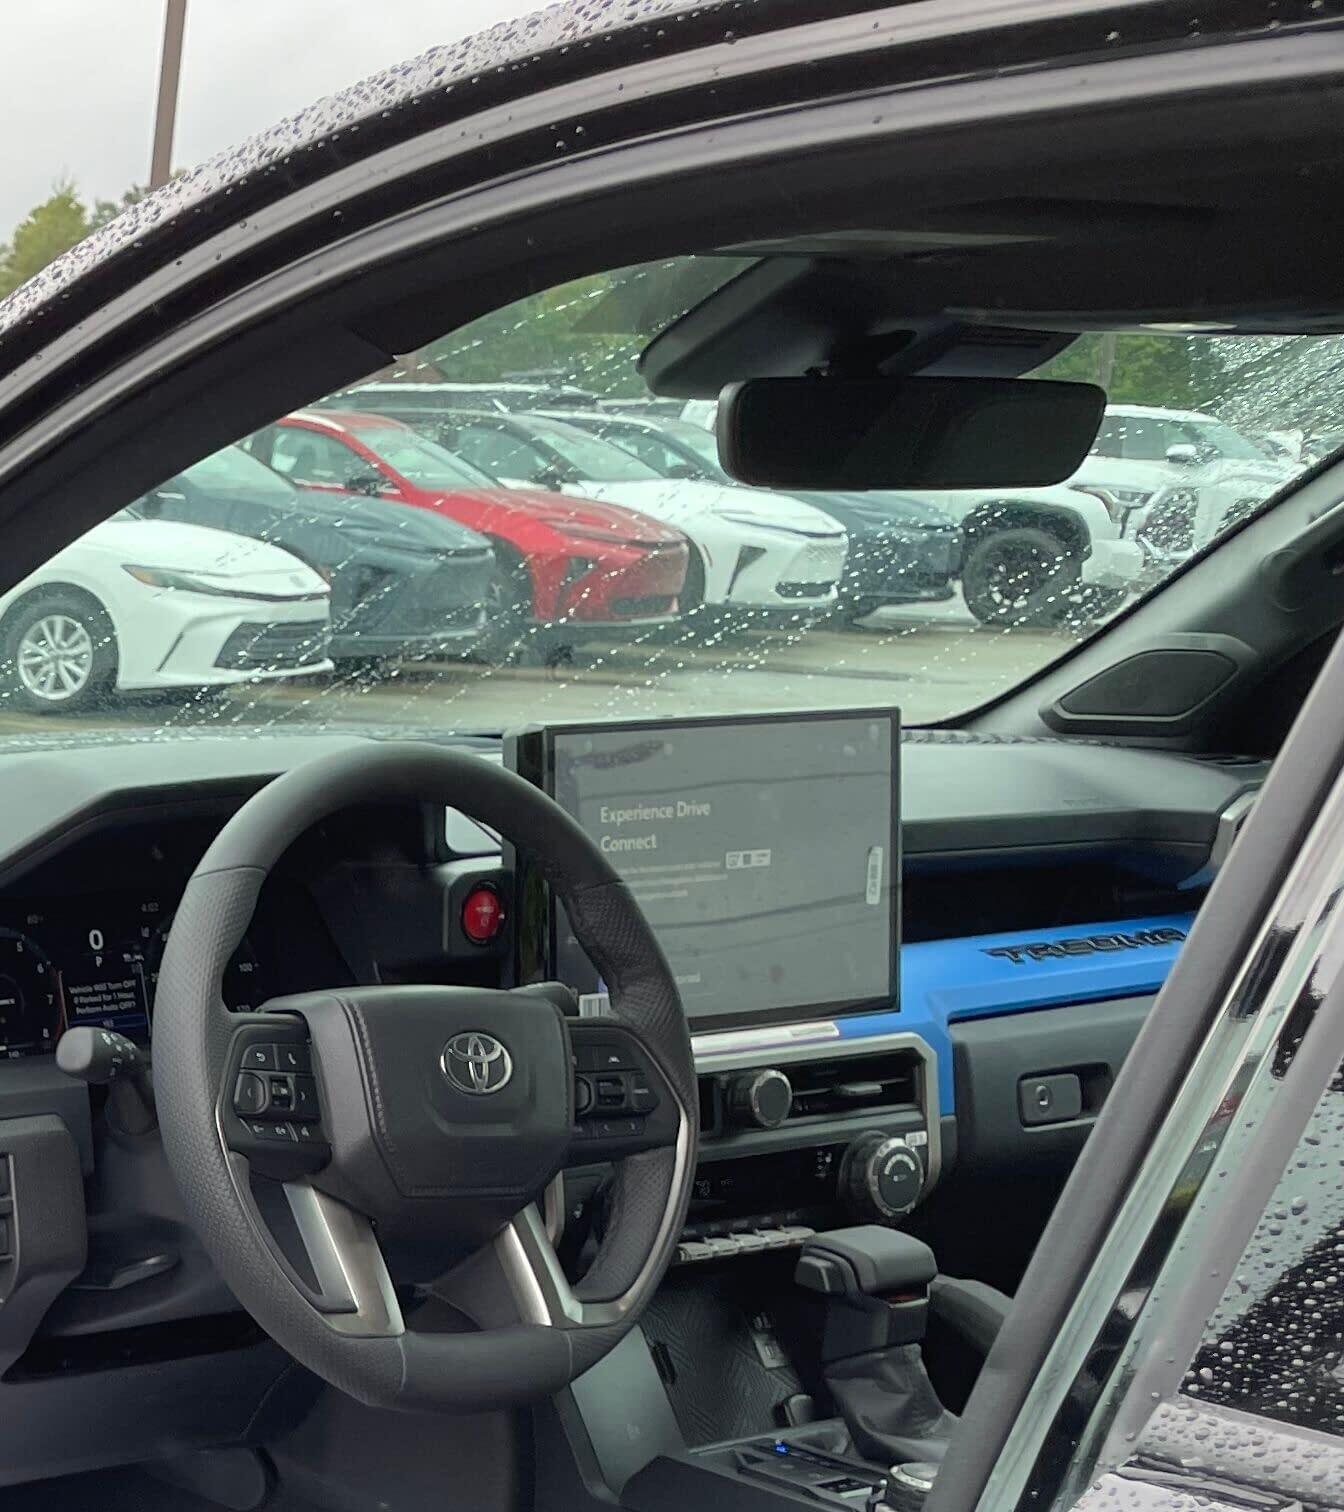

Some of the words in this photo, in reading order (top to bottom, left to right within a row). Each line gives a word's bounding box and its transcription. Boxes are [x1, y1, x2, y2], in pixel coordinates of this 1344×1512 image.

[600, 804, 674, 826] Experience
[677, 801, 711, 817] Drive
[600, 835, 657, 852] Connect
[89, 929, 104, 951] 0
[978, 927, 1189, 964] TACOMA
